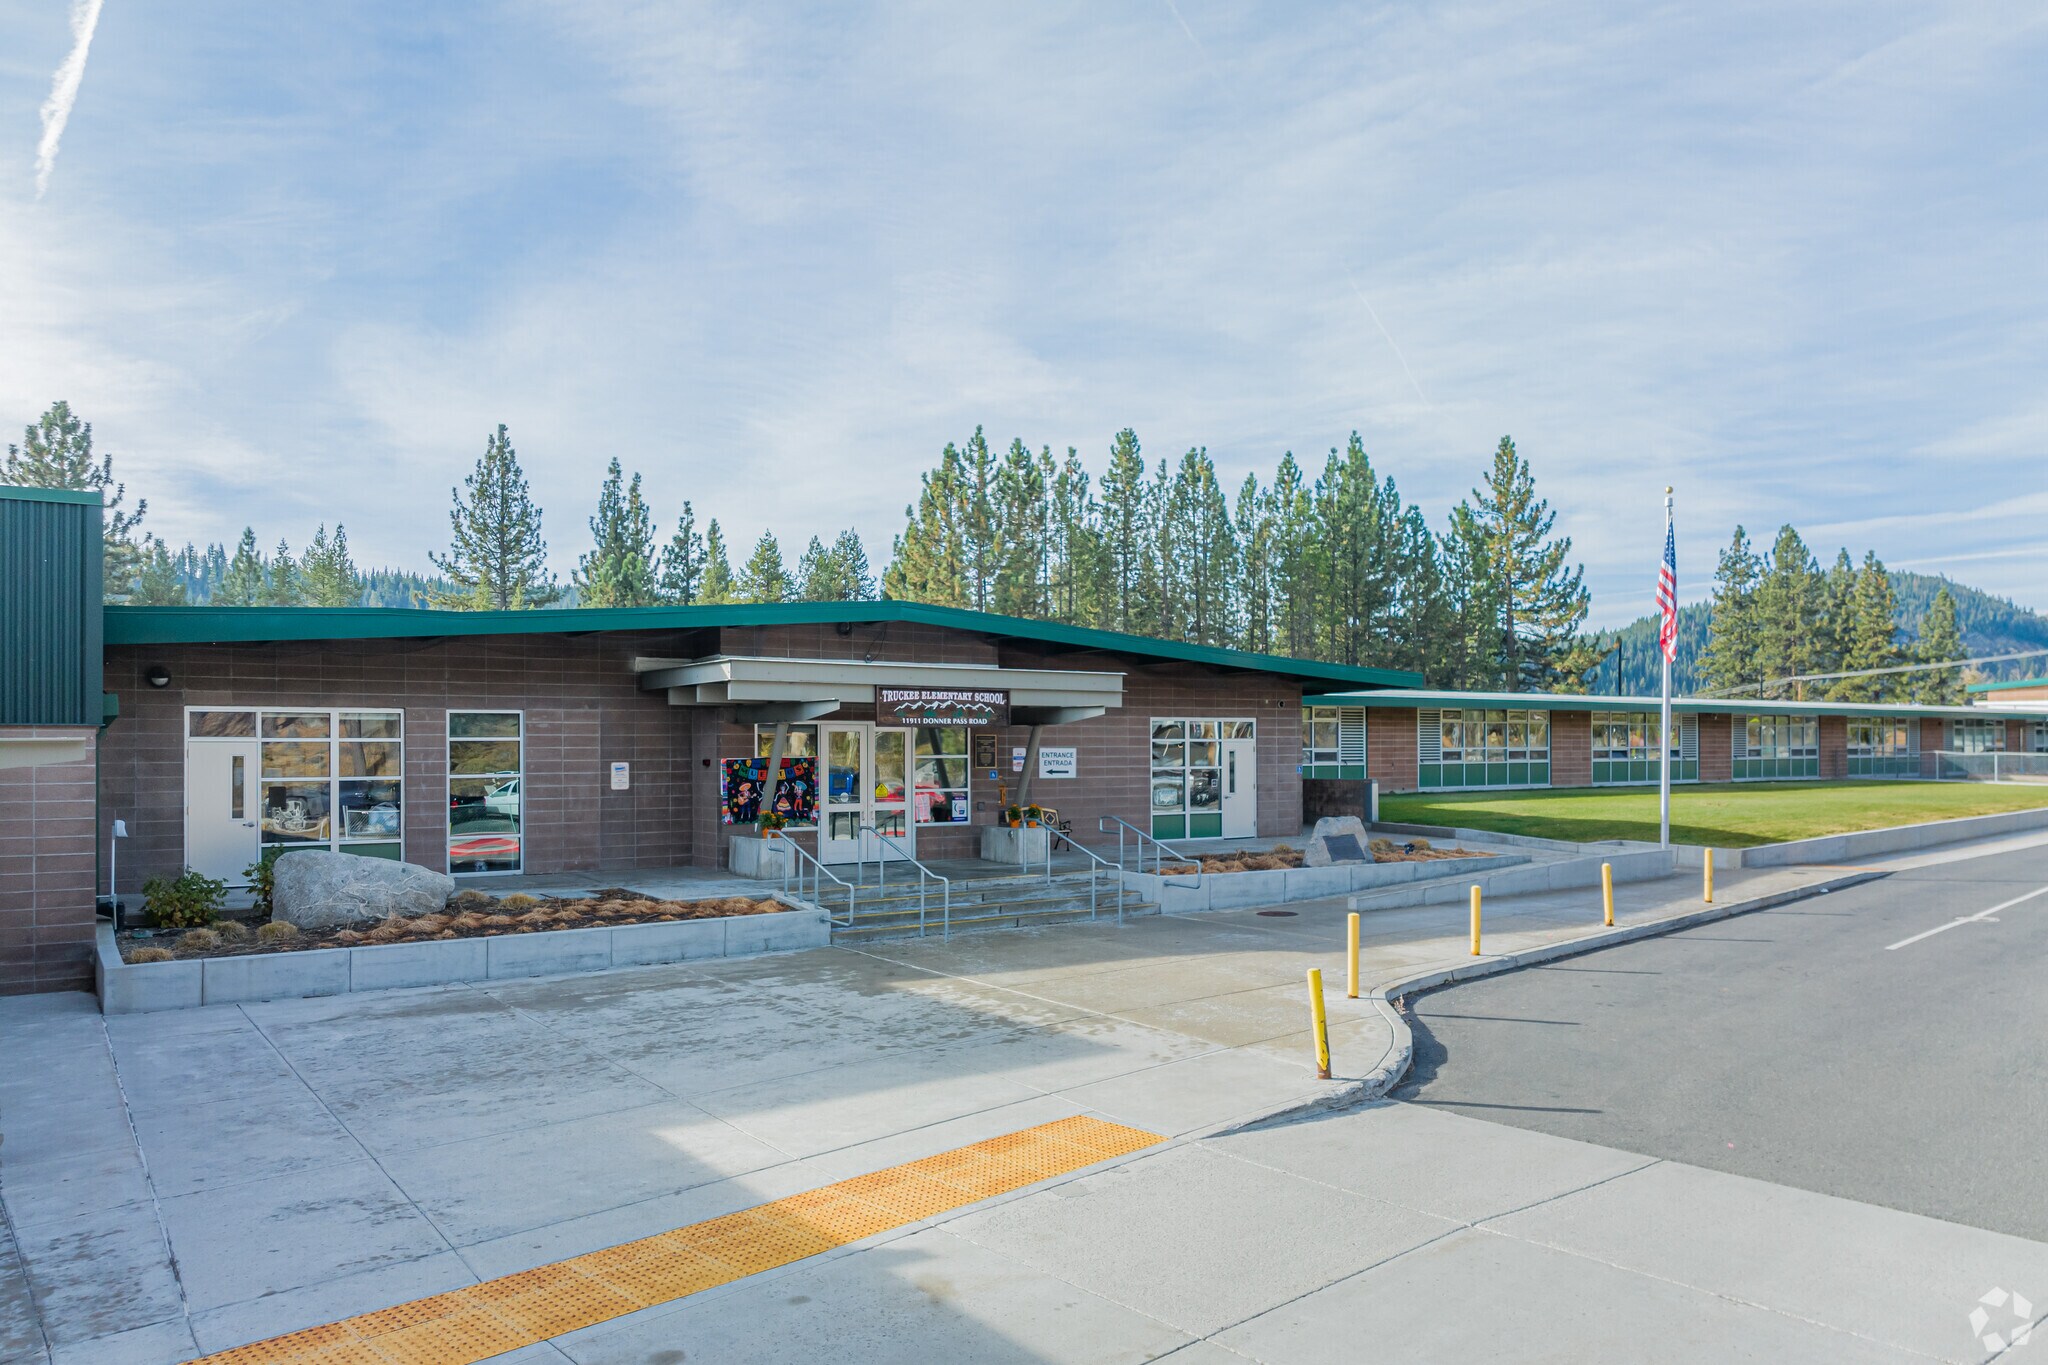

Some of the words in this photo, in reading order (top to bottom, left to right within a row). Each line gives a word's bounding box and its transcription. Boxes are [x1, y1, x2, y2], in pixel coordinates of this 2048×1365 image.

[882, 690, 920, 702] TRUCKEE
[921, 691, 973, 701] ELEMENTARY
[974, 692, 1005, 705] SCHOOL
[923, 717, 952, 725] DONNER
[740, 765, 803, 778] MUETOS
